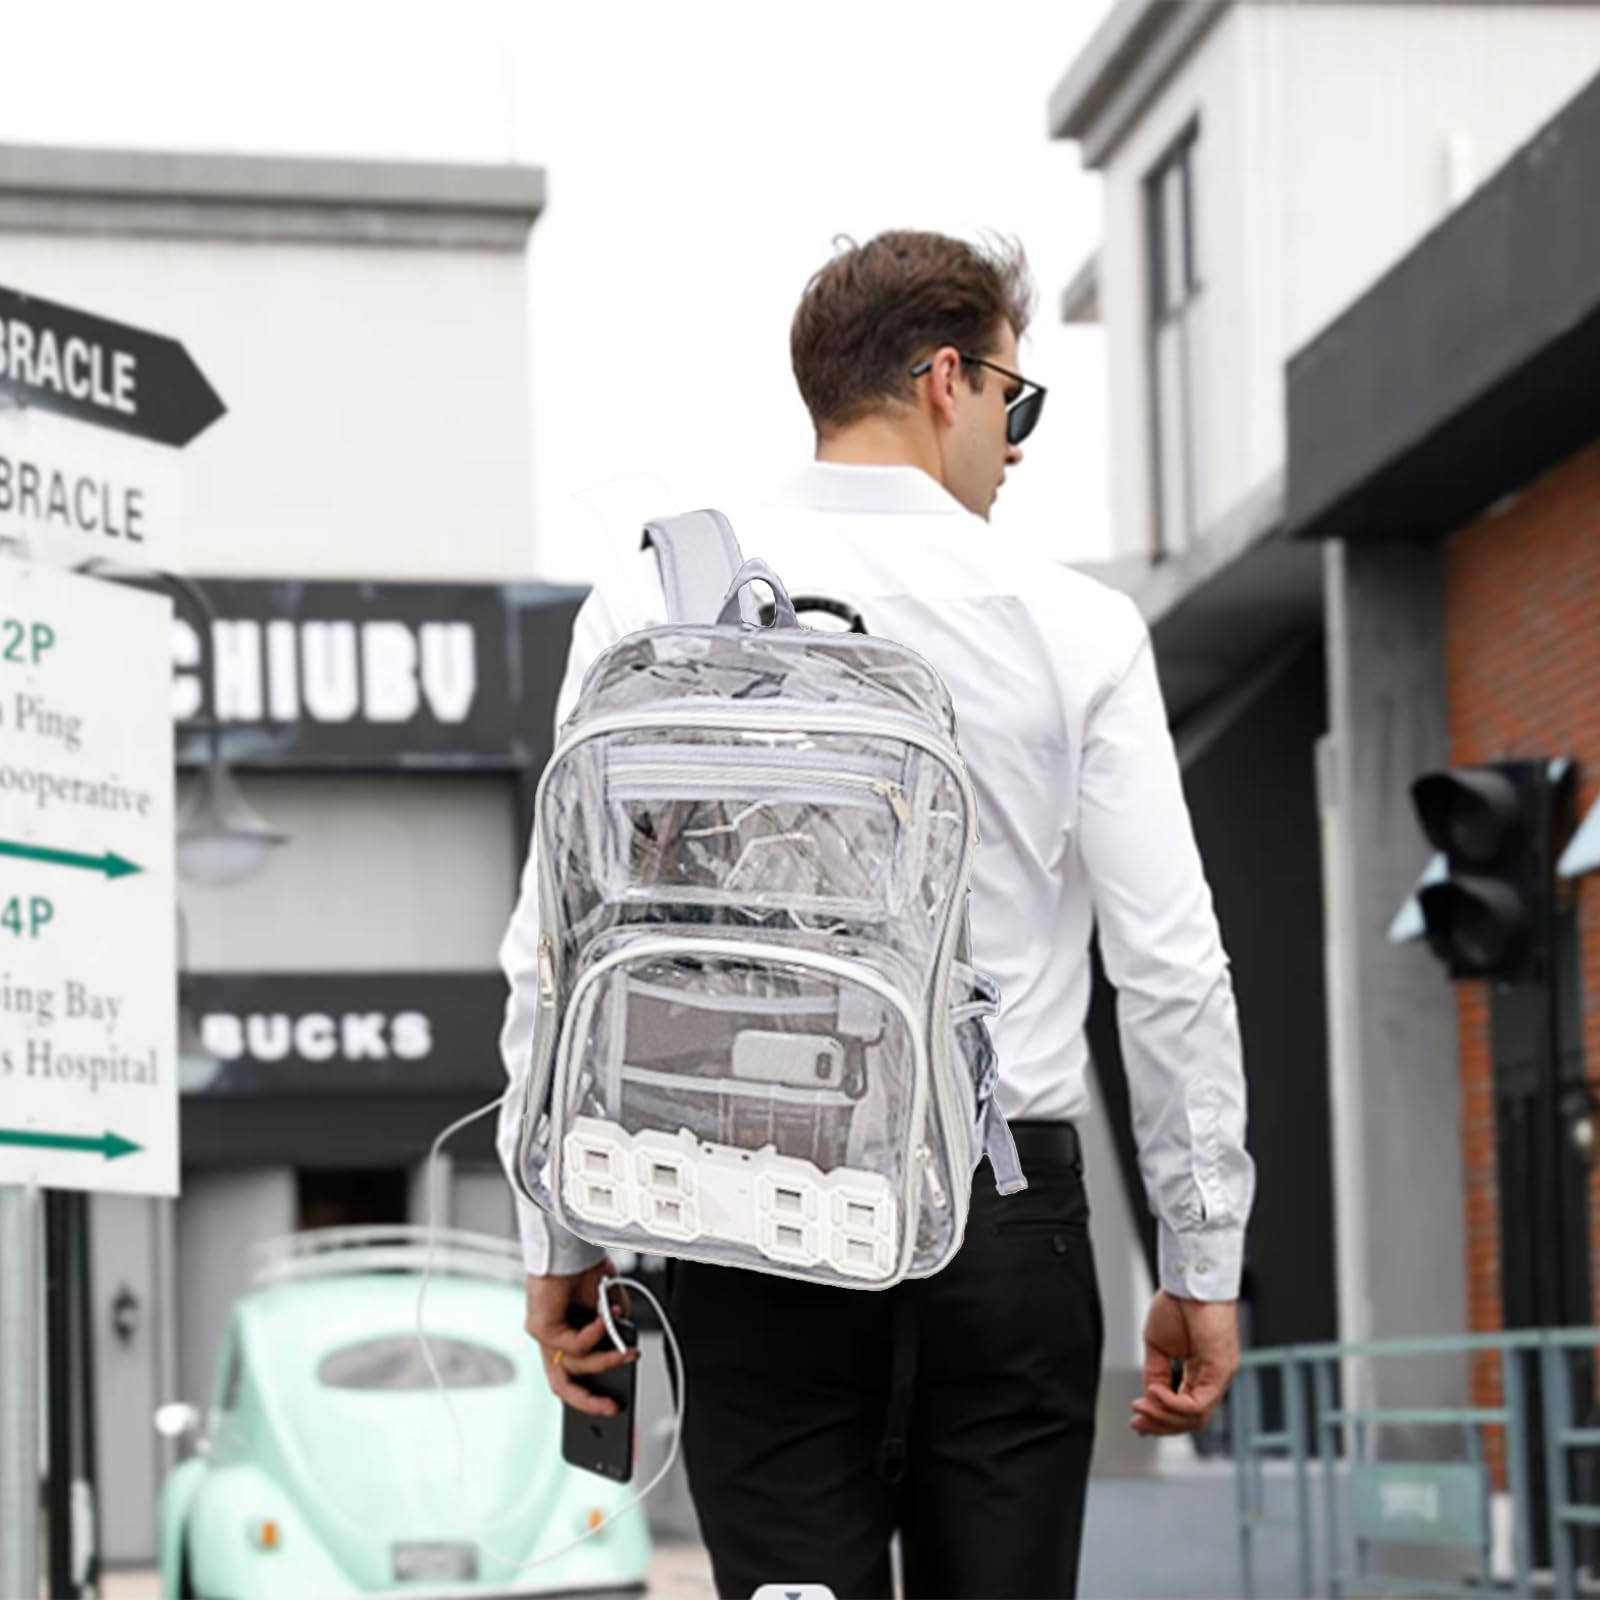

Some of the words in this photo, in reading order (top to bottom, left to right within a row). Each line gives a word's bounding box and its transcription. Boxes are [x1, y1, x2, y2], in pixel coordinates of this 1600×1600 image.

[0, 315, 136, 415] RACLE
[2, 619, 54, 663] 2P
[15, 691, 82, 752] Ping
[0, 894, 53, 938] 4P
[66, 979, 122, 1034] Bay
[201, 1012, 431, 1061] BUCKS
[27, 1038, 157, 1093] Hospital
